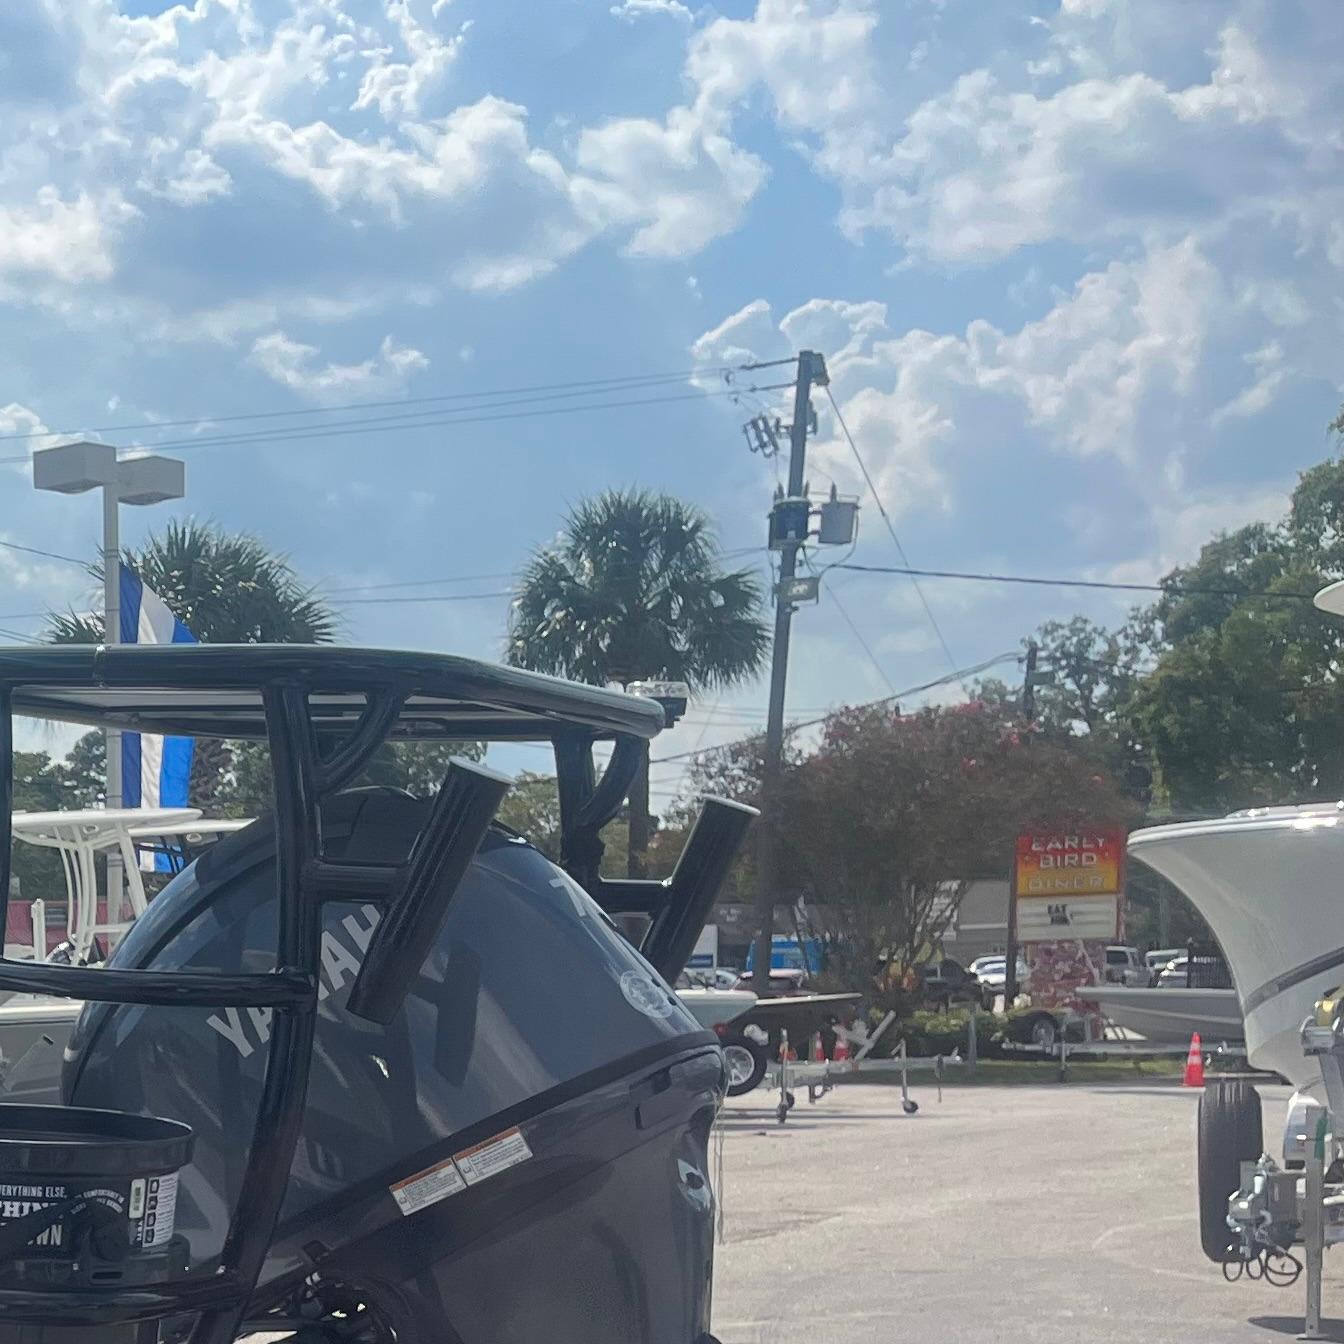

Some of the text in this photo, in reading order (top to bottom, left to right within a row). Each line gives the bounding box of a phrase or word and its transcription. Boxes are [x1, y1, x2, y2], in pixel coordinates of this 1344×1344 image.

[1031, 836, 1105, 851] EARLY
[1039, 852, 1097, 868] BIRD
[1028, 876, 1104, 890] DINER
